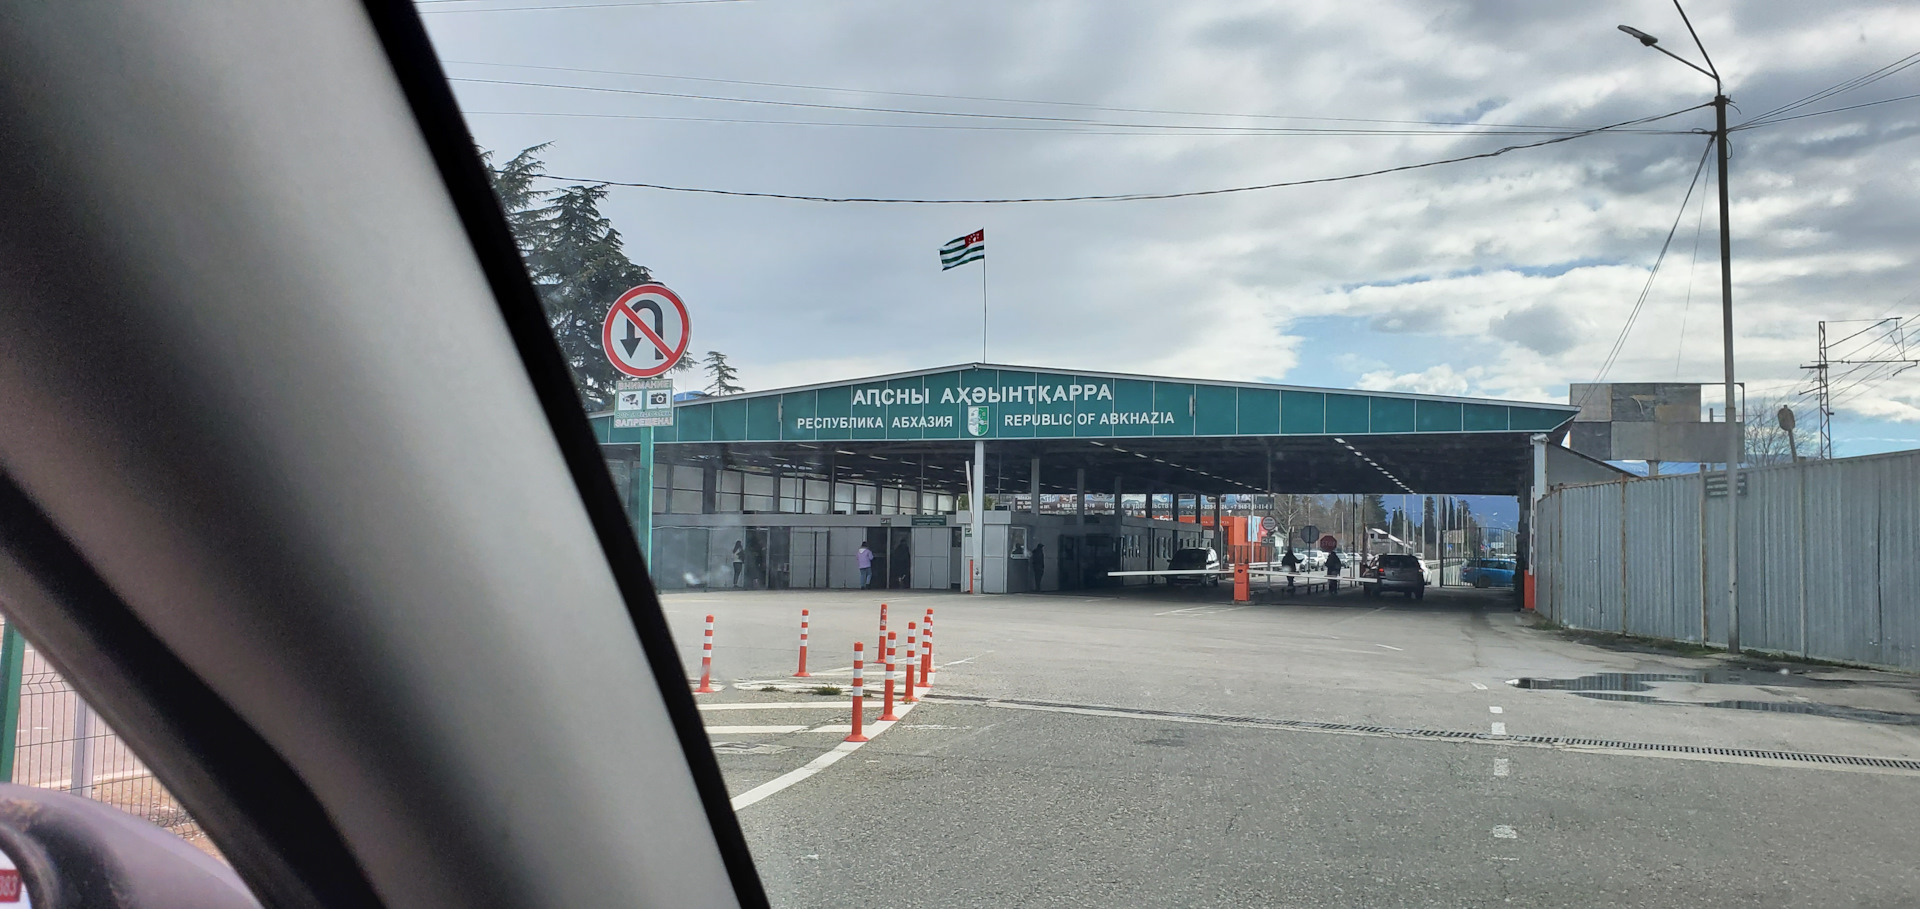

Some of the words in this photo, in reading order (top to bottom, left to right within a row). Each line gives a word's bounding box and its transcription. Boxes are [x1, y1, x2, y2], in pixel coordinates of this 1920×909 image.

[797, 416, 884, 429] РЕСПУБЛИКА
[892, 415, 953, 429] АБХАЗИЯ
[1004, 413, 1072, 427] REPUBLIC
[1077, 413, 1095, 426] OF
[1099, 411, 1175, 425] ABKHAZIA
